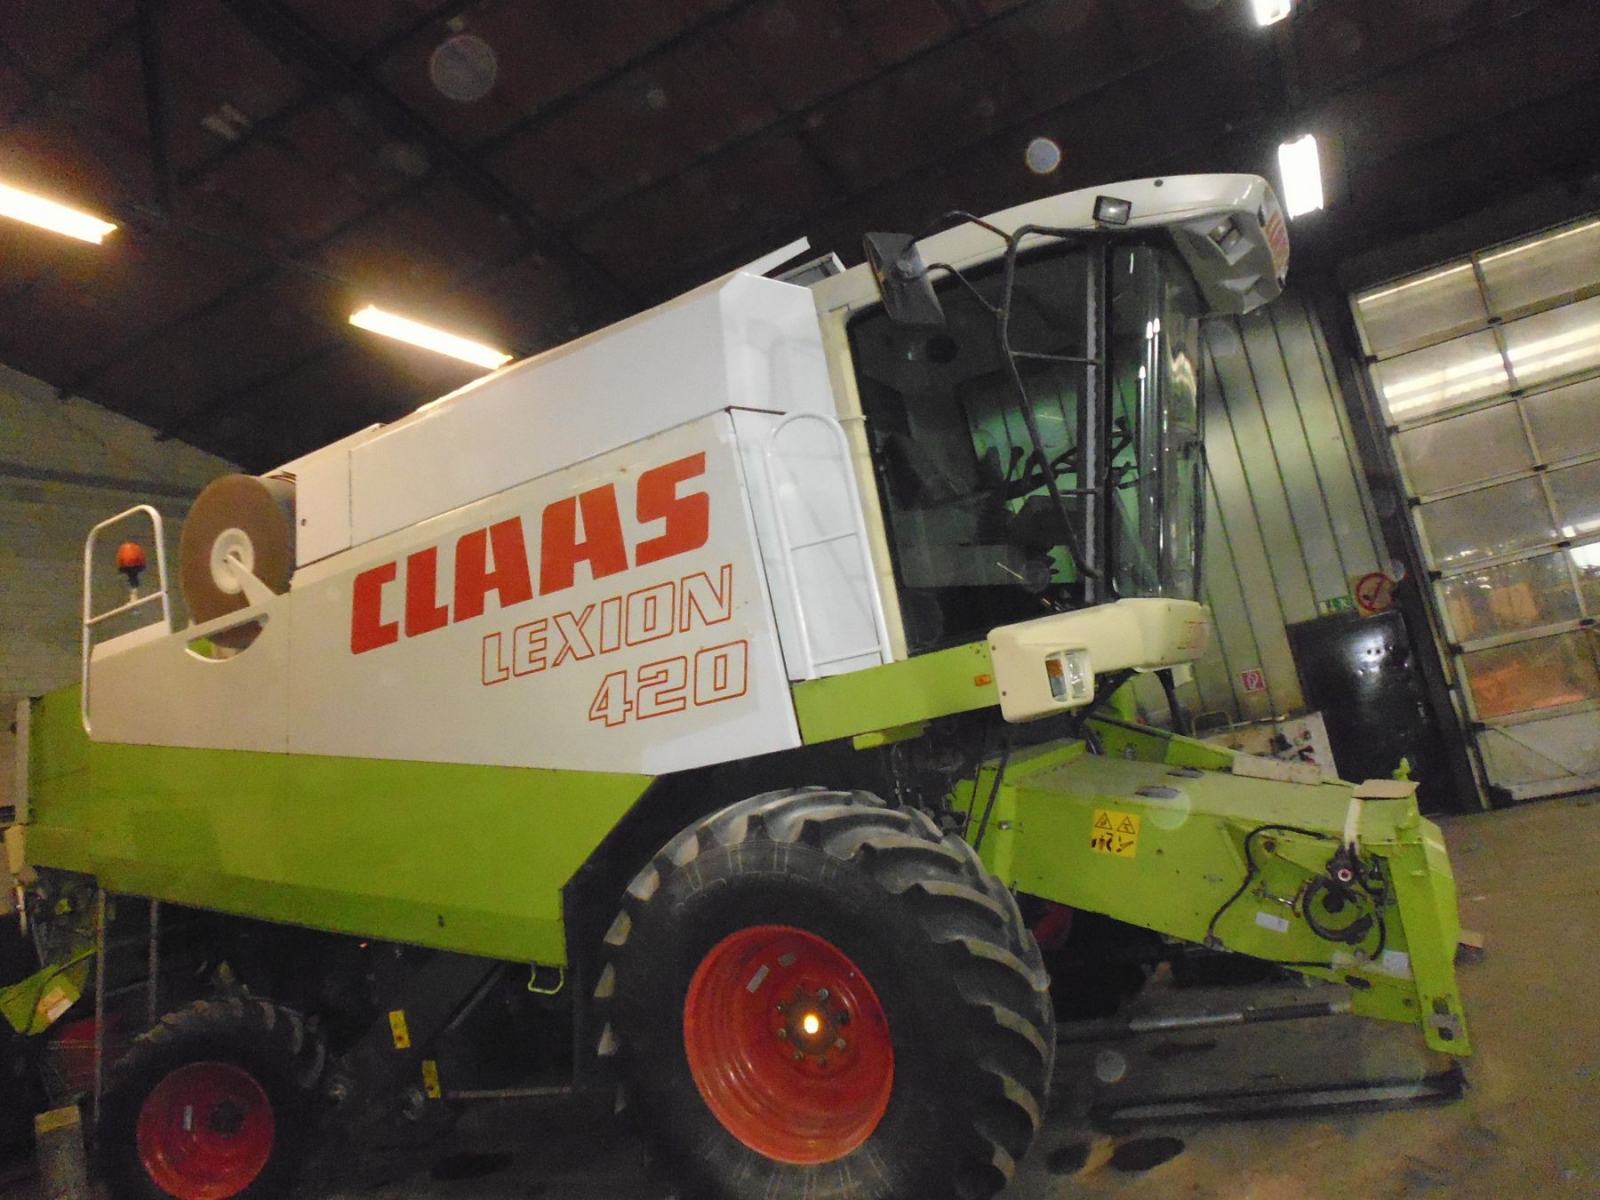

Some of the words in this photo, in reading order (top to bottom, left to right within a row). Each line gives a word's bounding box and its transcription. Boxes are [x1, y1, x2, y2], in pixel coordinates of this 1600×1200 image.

[350, 451, 711, 655] CLAAS
[481, 563, 733, 686] LEXION
[588, 639, 749, 728] 420
